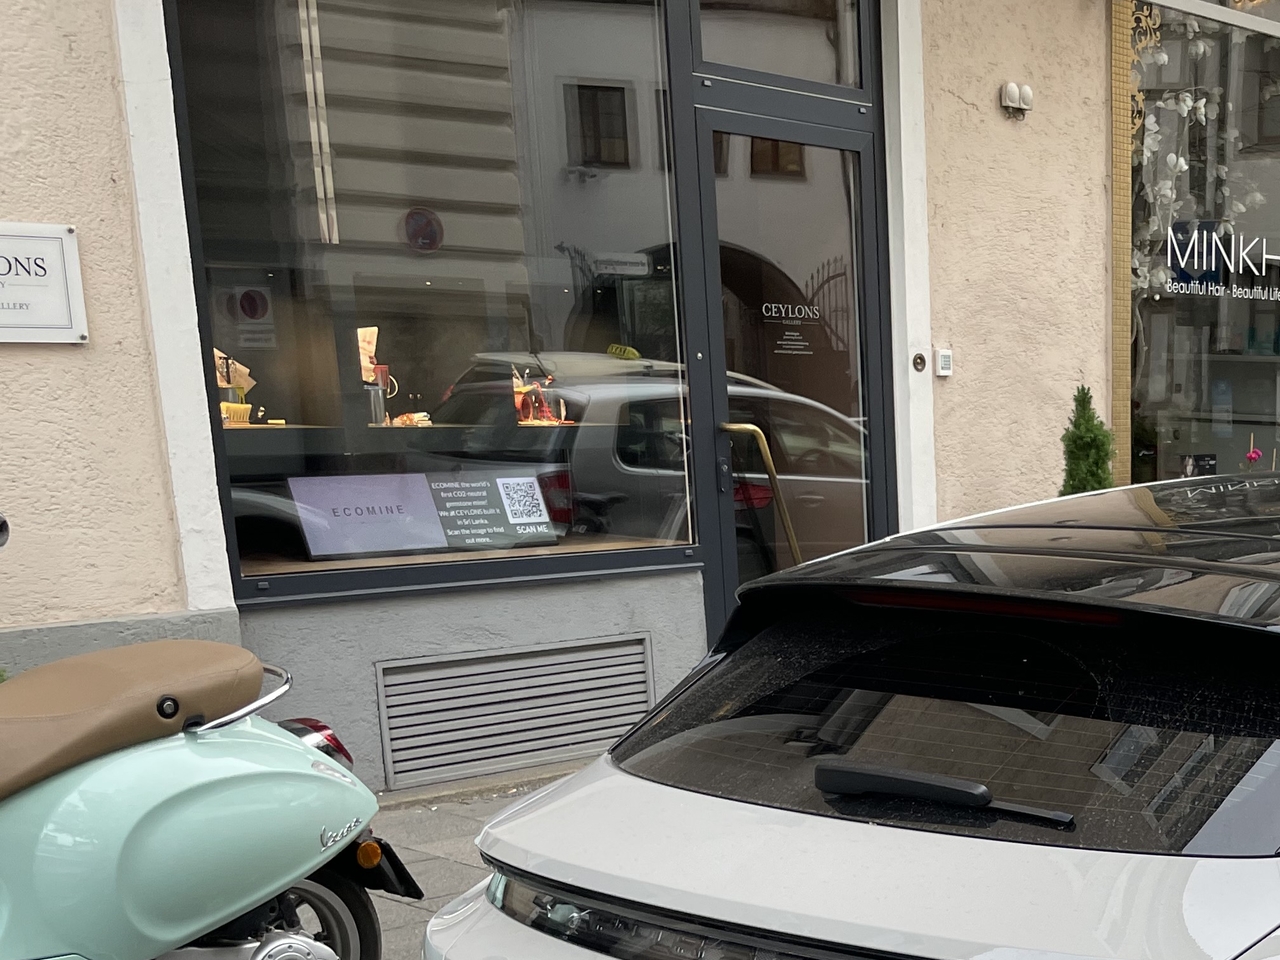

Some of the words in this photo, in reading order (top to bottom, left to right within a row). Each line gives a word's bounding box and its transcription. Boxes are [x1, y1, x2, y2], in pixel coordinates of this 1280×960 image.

[1167, 279, 1206, 295] Beautiful
[1208, 282, 1226, 297] Hair
[1232, 284, 1268, 300] Beautiful
[762, 303, 820, 319] CEYLONS
[431, 481, 460, 489] ECOMINE
[331, 505, 405, 517] ECOMINE
[516, 525, 536, 534] SCAN
[536, 524, 549, 533] ME
